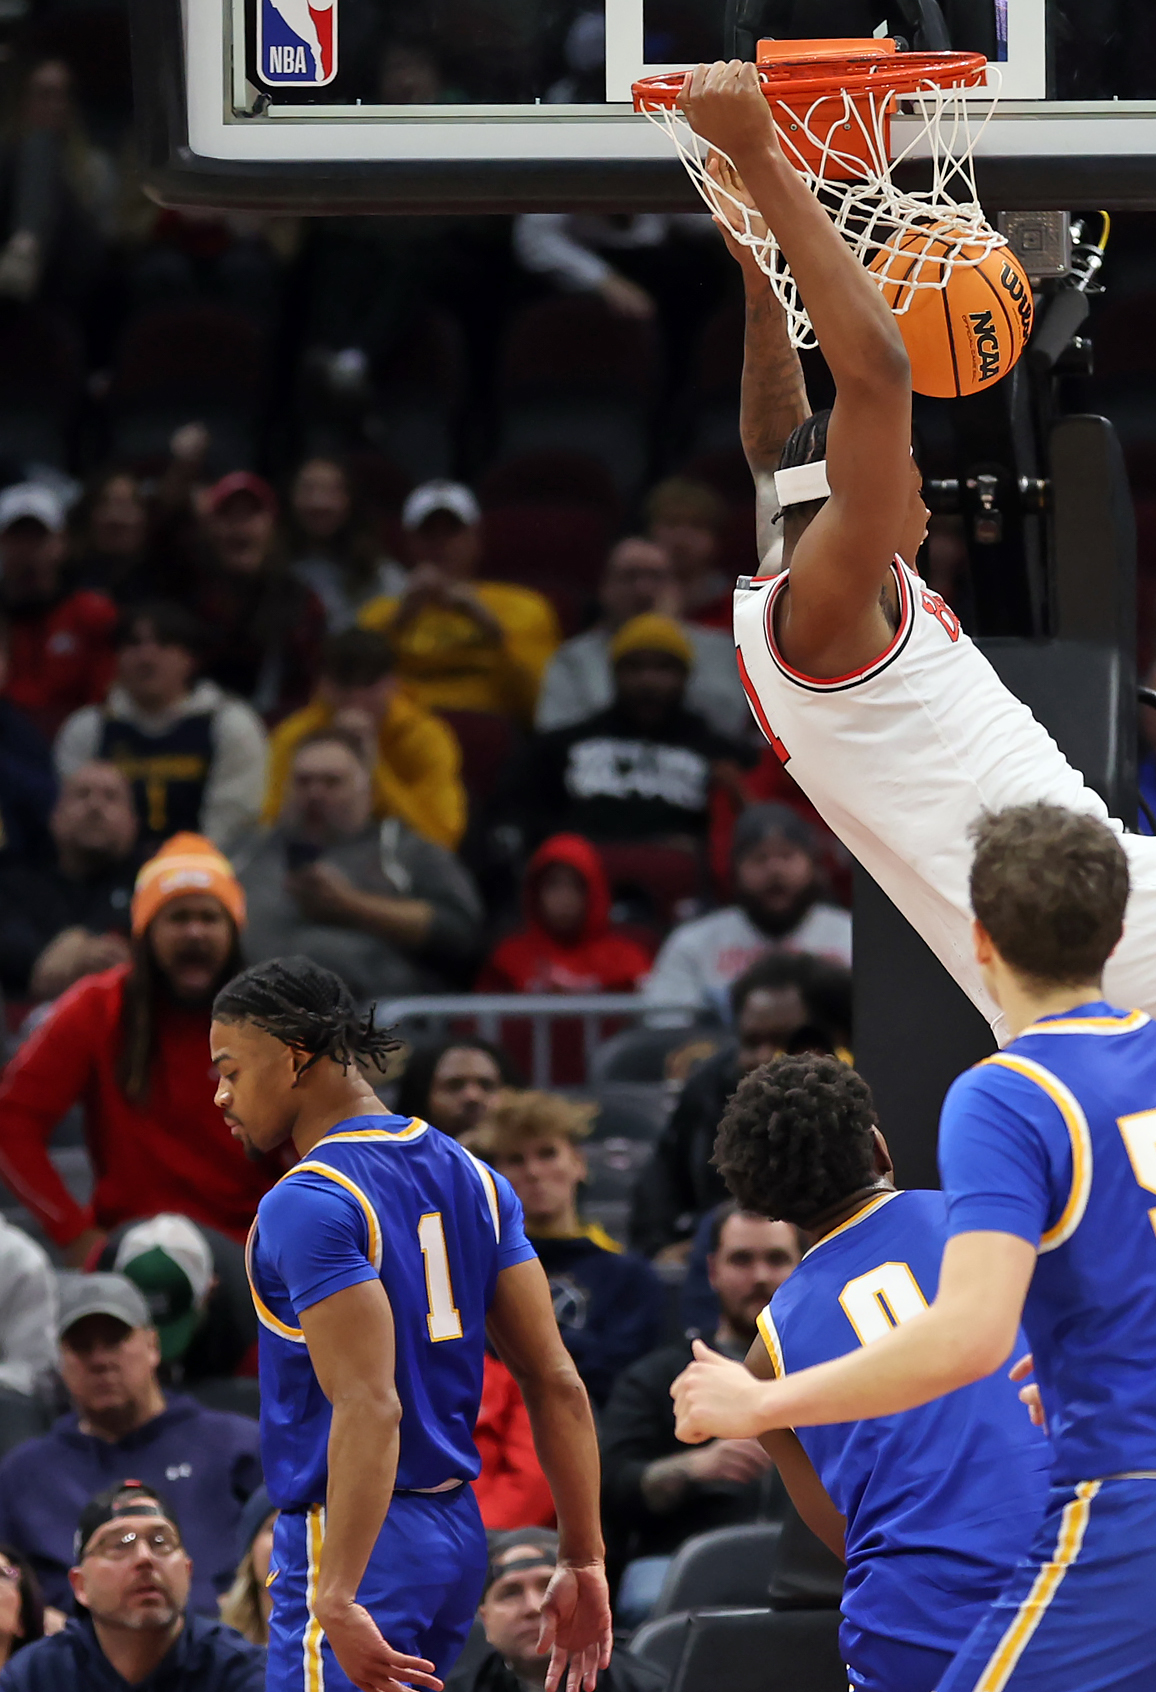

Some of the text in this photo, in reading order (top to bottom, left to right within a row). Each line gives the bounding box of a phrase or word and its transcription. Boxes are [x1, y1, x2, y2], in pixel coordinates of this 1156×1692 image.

[269, 46, 307, 74] NBA
[968, 309, 1000, 383] NCAA
[417, 1211, 464, 1343] 1
